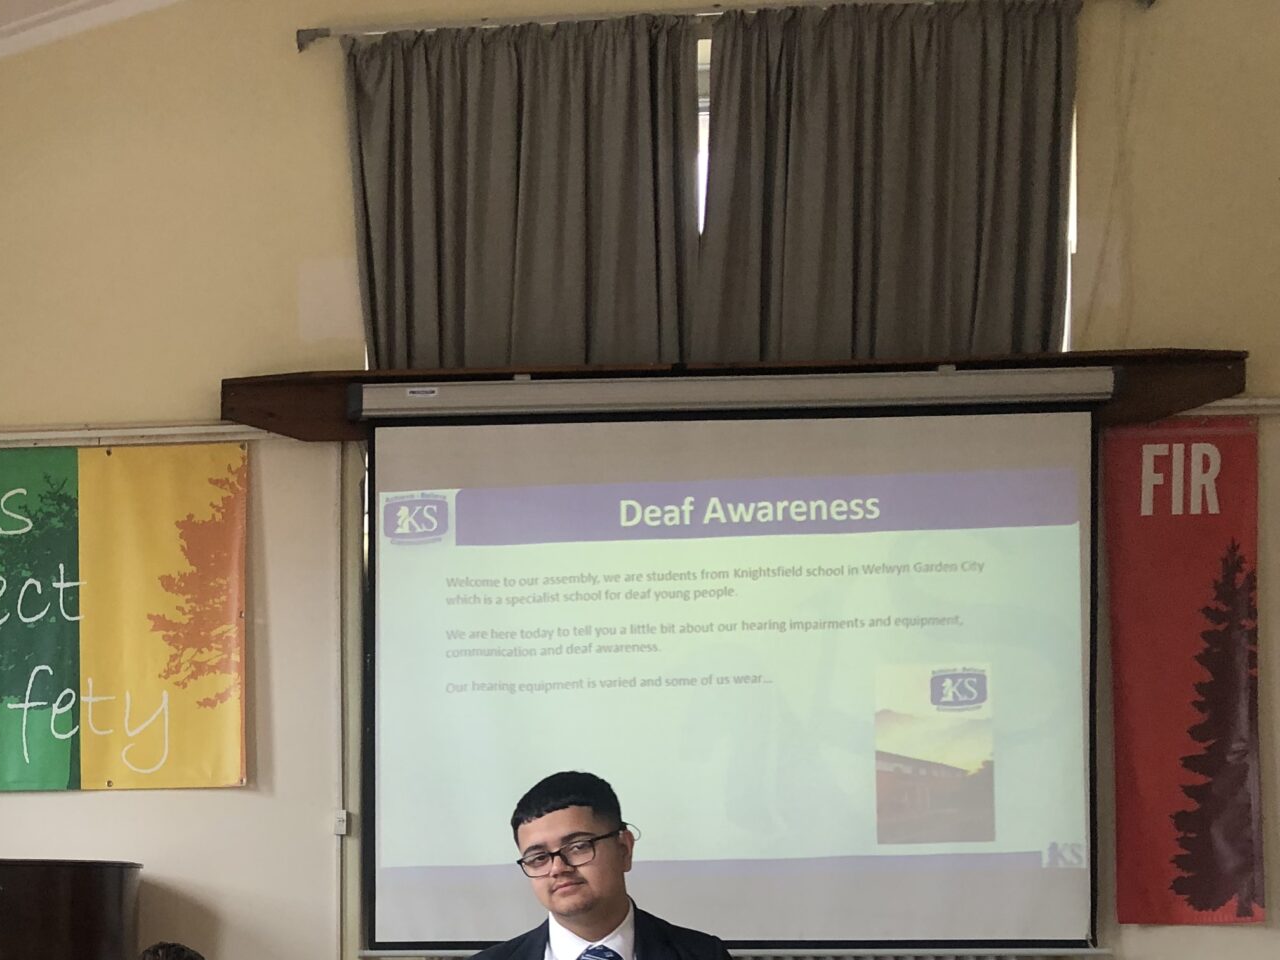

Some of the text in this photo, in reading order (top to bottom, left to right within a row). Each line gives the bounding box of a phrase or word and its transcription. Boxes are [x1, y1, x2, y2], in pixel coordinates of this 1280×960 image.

[1140, 442, 1221, 516] FIR
[620, 496, 880, 527] Deaf Awareness
[446, 560, 984, 588] Welcome to our assembly, we are students from Knightsfield school in Welwyn Garden City
[446, 586, 738, 607] which is a specialist school for deaf young people.
[446, 614, 964, 641] We are here today to tell you a little bit about our hearing impairments and equipment,
[446, 642, 662, 658] communication and deaf awareness.
[446, 682, 468, 694] Our
[471, 680, 516, 694] hearing
[519, 678, 583, 693] equipment
[587, 677, 597, 689] is
[600, 677, 636, 688] varied
[640, 676, 662, 687] and
[665, 677, 697, 687] some
[701, 674, 713, 686] of
[716, 675, 730, 685] us
